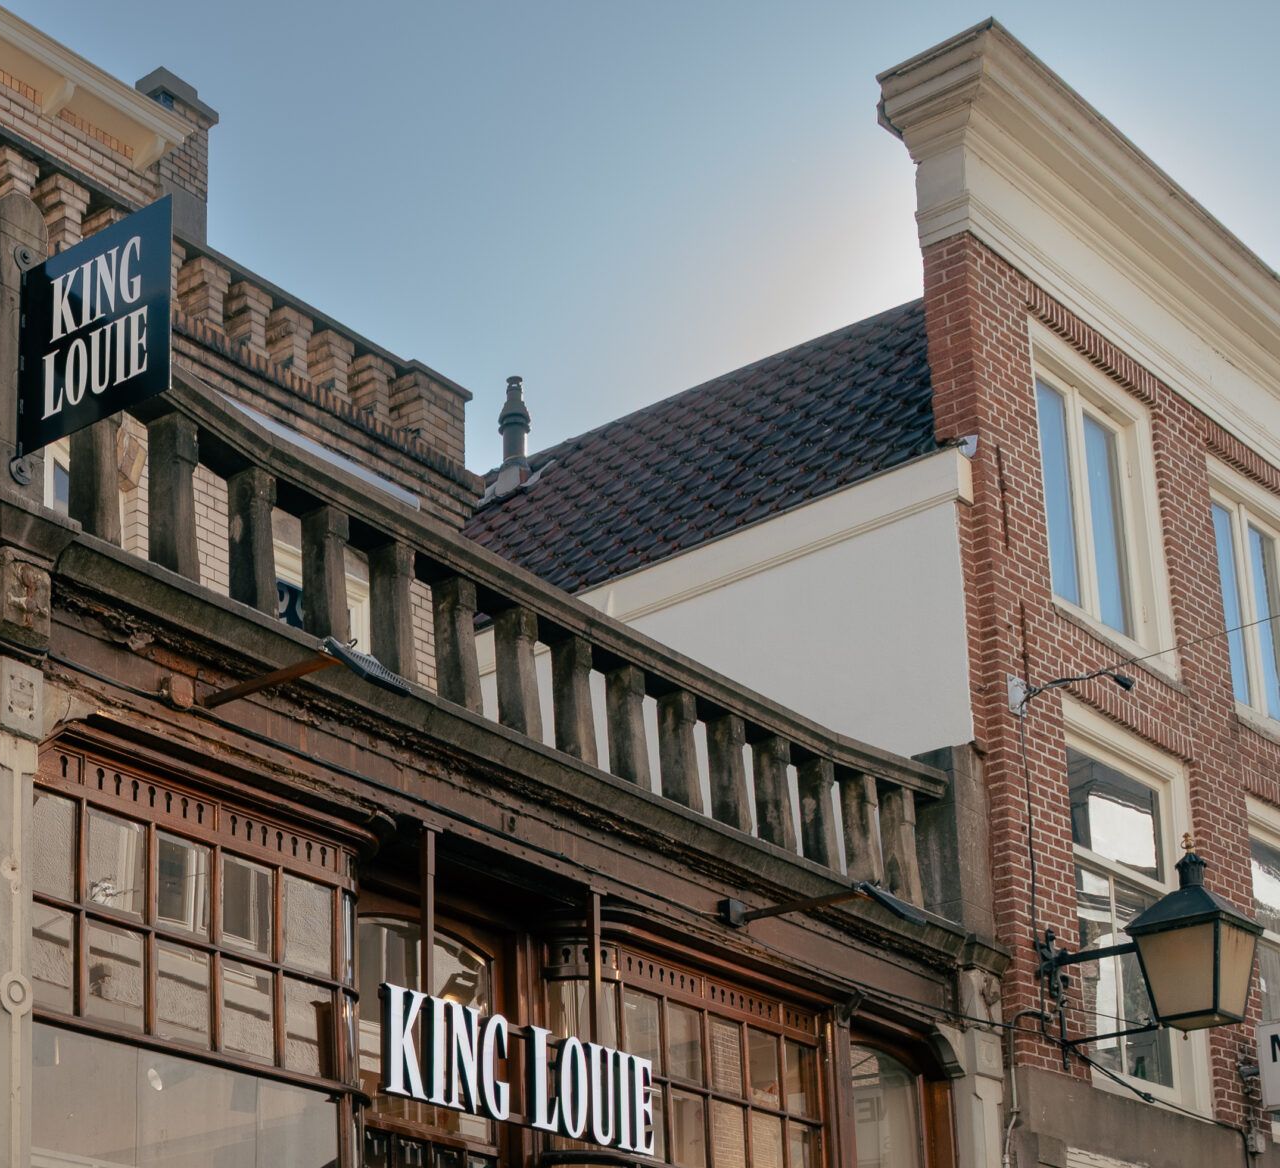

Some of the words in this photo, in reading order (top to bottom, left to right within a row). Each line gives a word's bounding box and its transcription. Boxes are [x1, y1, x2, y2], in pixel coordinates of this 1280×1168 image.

[49, 235, 141, 344] KING
[40, 305, 148, 421] LOUIE
[381, 982, 510, 1121] KING
[528, 1025, 655, 1156] LOUIE
